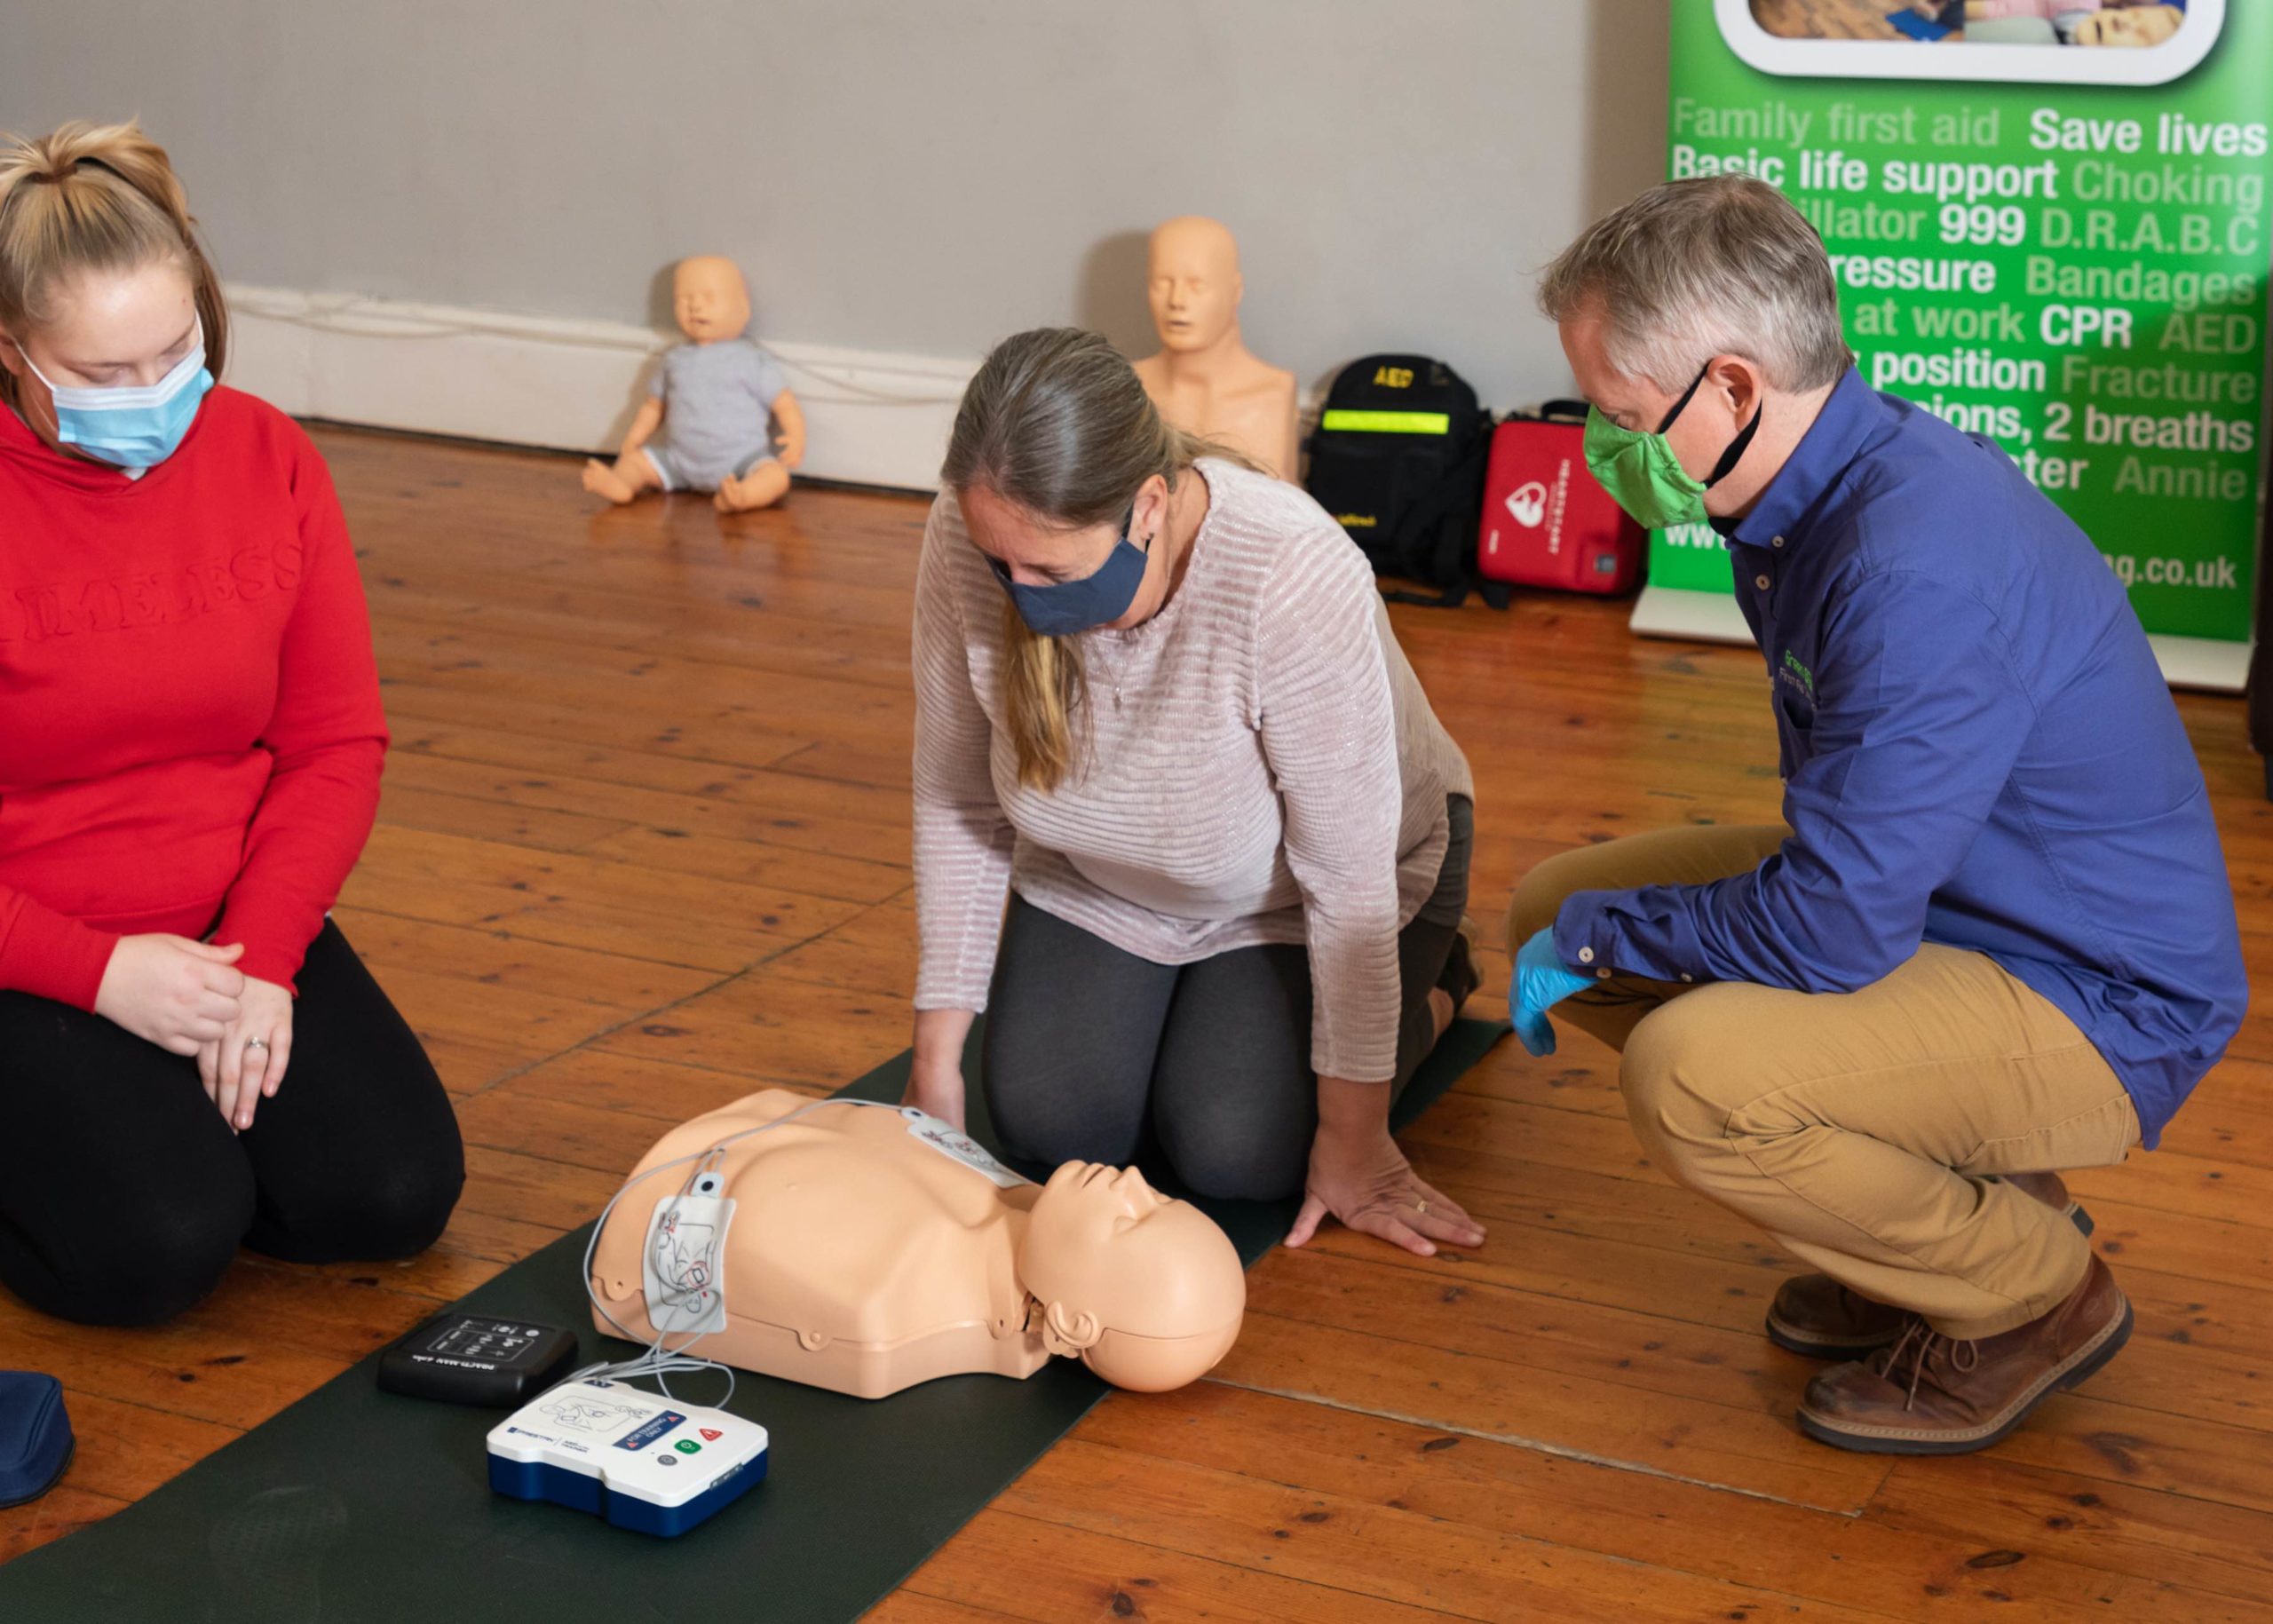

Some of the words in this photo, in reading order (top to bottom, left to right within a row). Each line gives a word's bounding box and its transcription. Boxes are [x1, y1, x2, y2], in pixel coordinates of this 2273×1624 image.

[1674, 97, 1813, 149] Family
[1827, 103, 1918, 145] first
[1931, 105, 2000, 147] aid
[2029, 107, 2142, 154] Save
[2158, 113, 2269, 157] lives
[1672, 144, 1785, 187] Basic
[1799, 149, 1868, 192] life
[1882, 159, 2059, 203] support
[2072, 159, 2263, 215] Choking
[1938, 203, 2025, 246] 999
[2040, 207, 2259, 257] D.R.A.B.C
[2025, 255, 2257, 311] Bandages
[1853, 297, 1899, 337] at
[1912, 302, 2025, 343] work
[2039, 304, 2133, 349] CPR
[2158, 312, 2257, 353] AED
[1373, 365, 1414, 388] AED
[1873, 347, 2046, 392] position
[2062, 354, 2256, 404] Fracture
[2043, 401, 2072, 441] 2
[2086, 403, 2253, 452] breaths
[2008, 448, 2089, 490] ter
[2113, 455, 2247, 501] Annie
